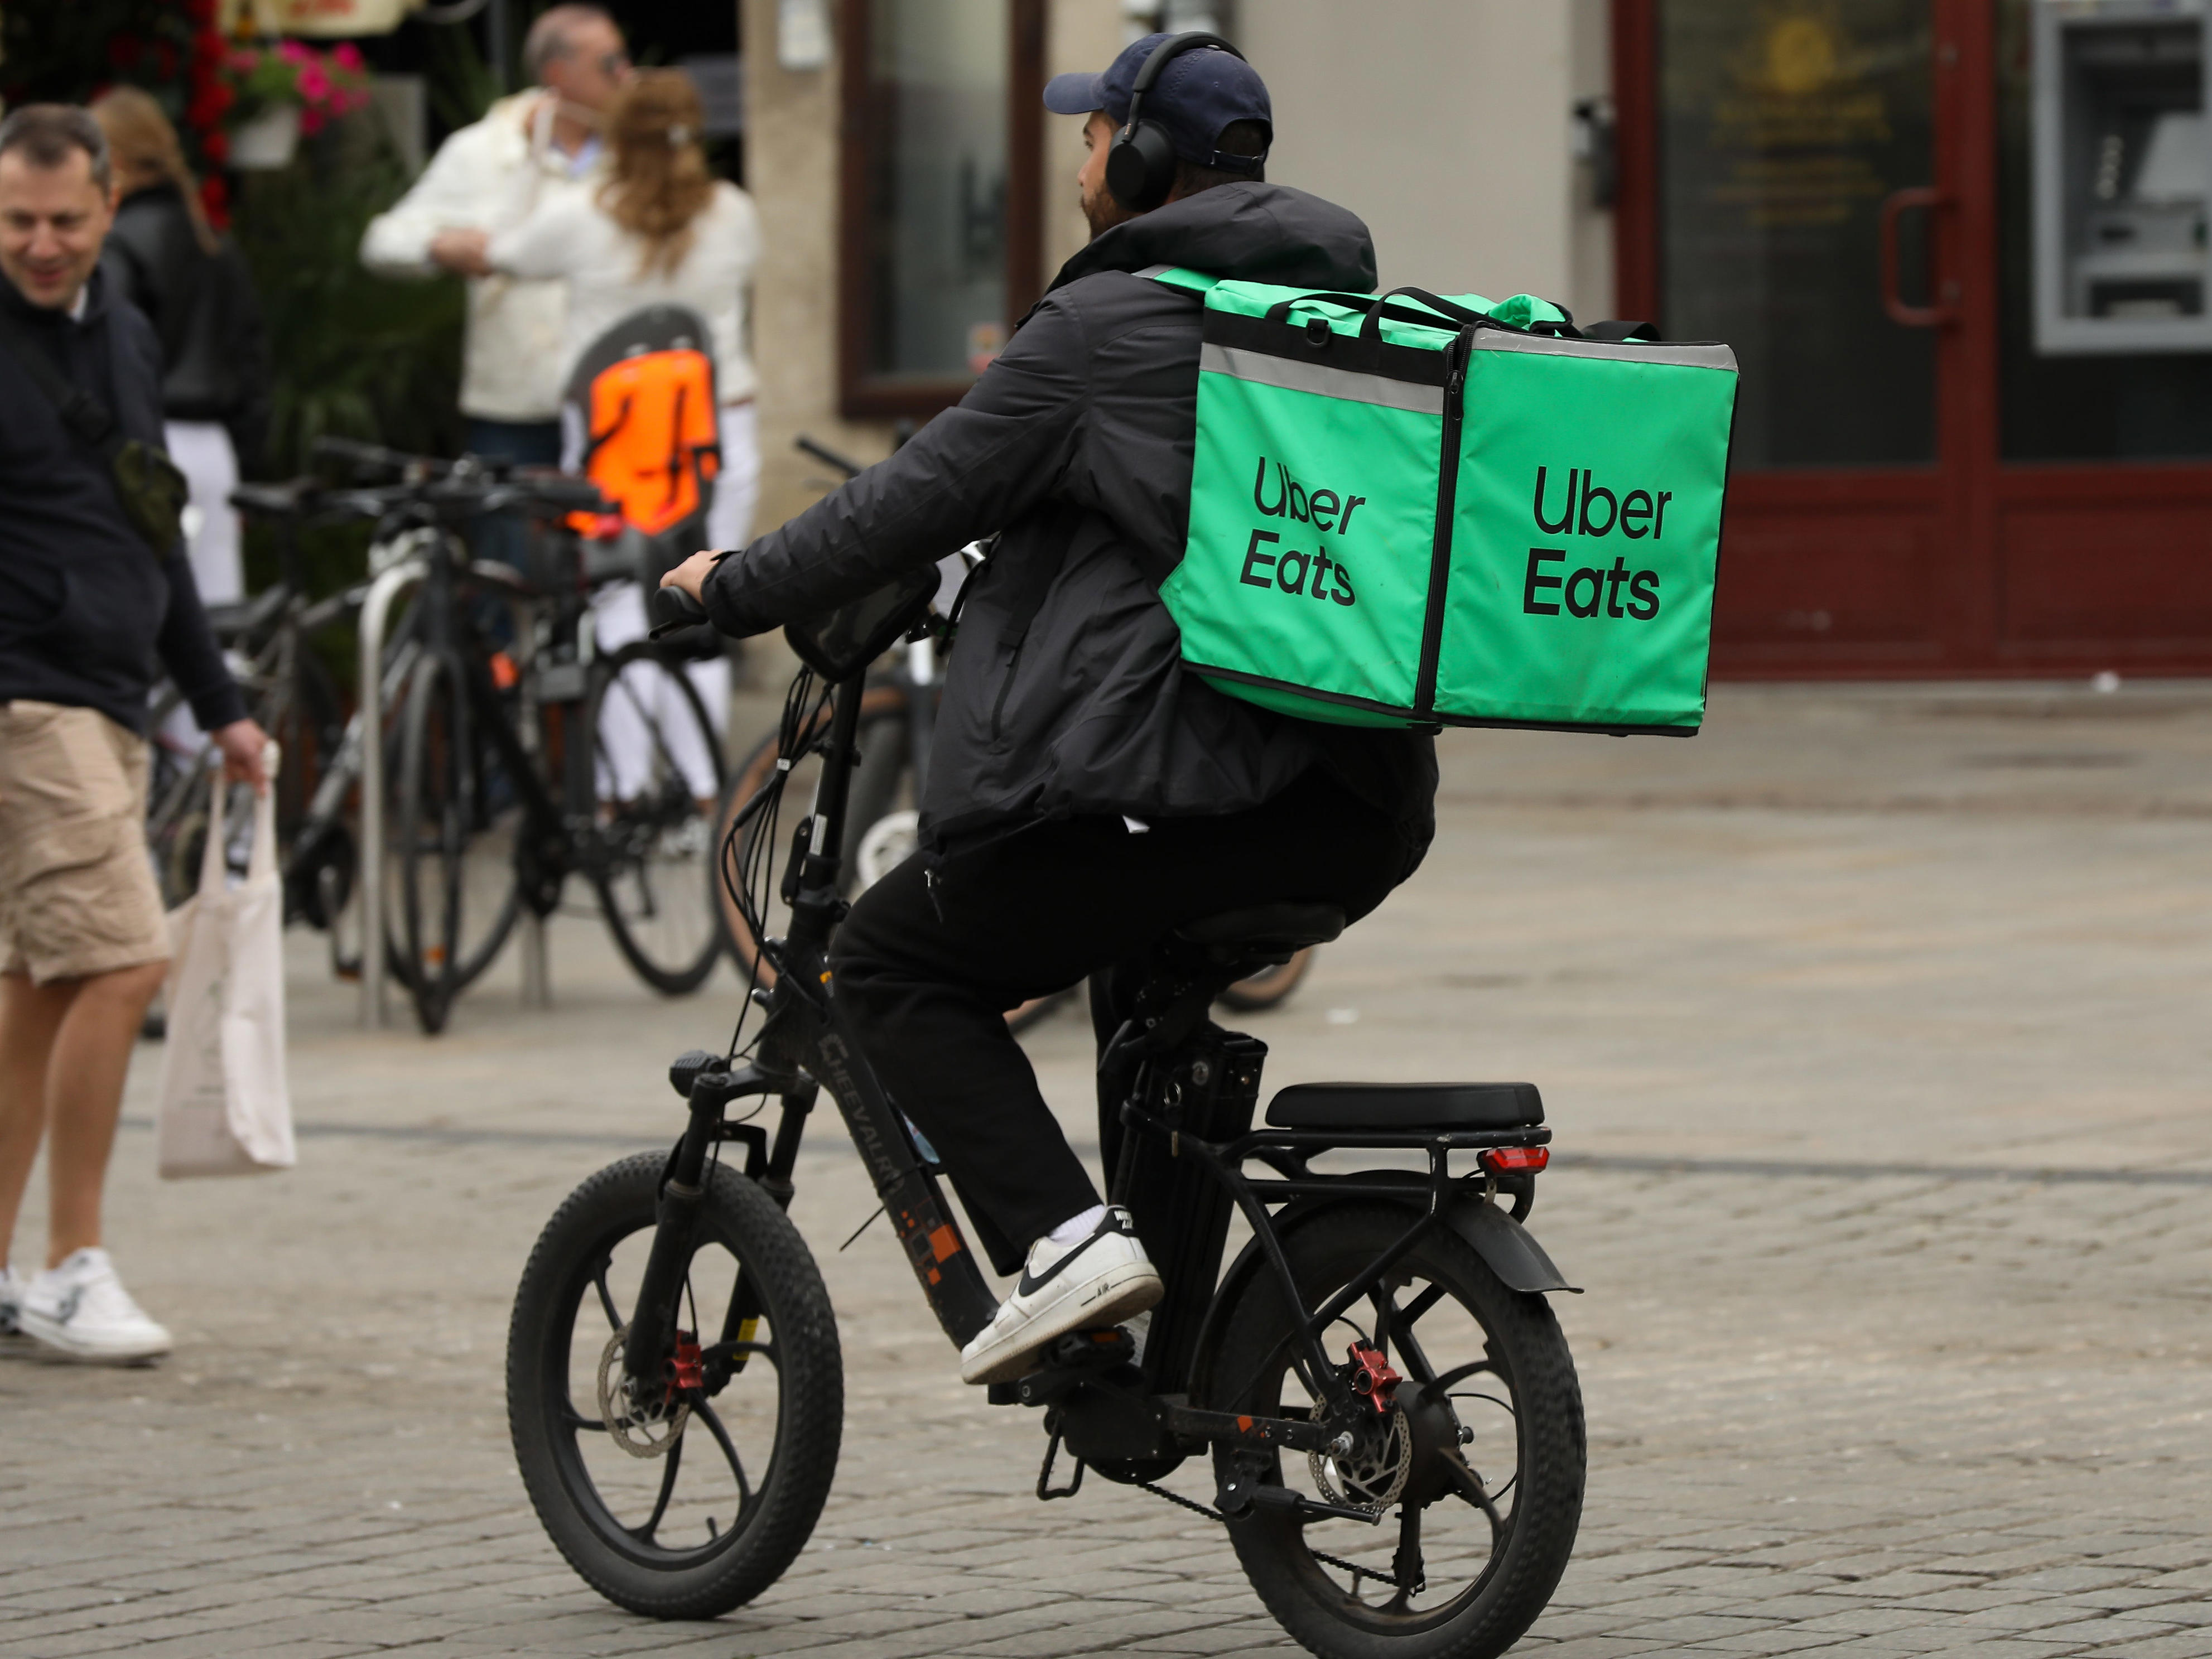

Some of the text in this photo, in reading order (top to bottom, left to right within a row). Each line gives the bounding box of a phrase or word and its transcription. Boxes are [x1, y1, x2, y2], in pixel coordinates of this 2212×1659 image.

[1254, 456, 1366, 536] Uber
[1533, 465, 1673, 540] Uber
[1239, 528, 1356, 607] Eats
[1522, 547, 1660, 621] Eats
